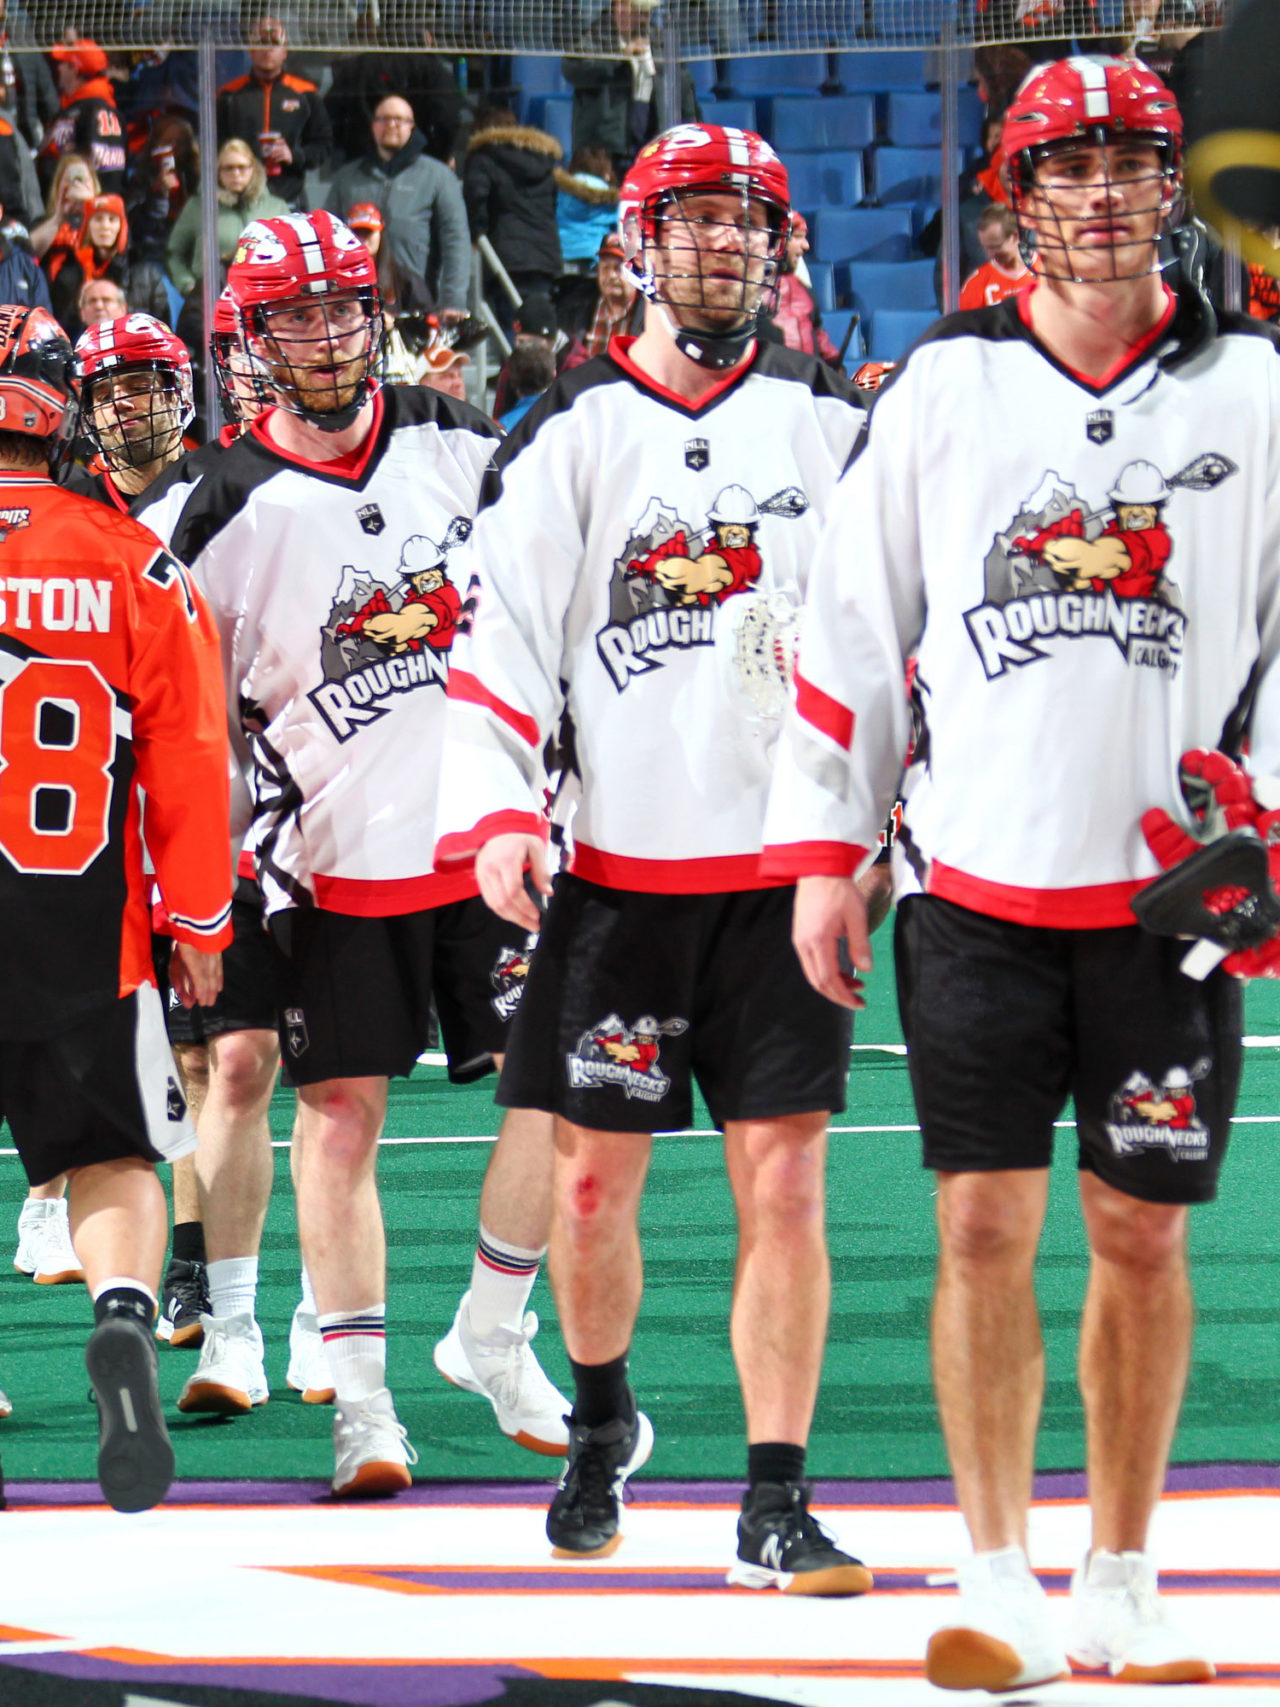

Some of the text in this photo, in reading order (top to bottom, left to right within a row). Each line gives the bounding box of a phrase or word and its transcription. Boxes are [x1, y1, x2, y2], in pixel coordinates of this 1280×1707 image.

[97, 109, 122, 136] 11
[1086, 411, 1113, 422] NLL
[684, 439, 709, 450] NLL
[357, 505, 380, 521] NLL
[142, 548, 199, 625] 7
[962, 589, 1189, 682] ROUGHNECKS
[567, 1054, 669, 1096] ROUGHNECKS
[1105, 1122, 1209, 1155] ROUGHNECKS
